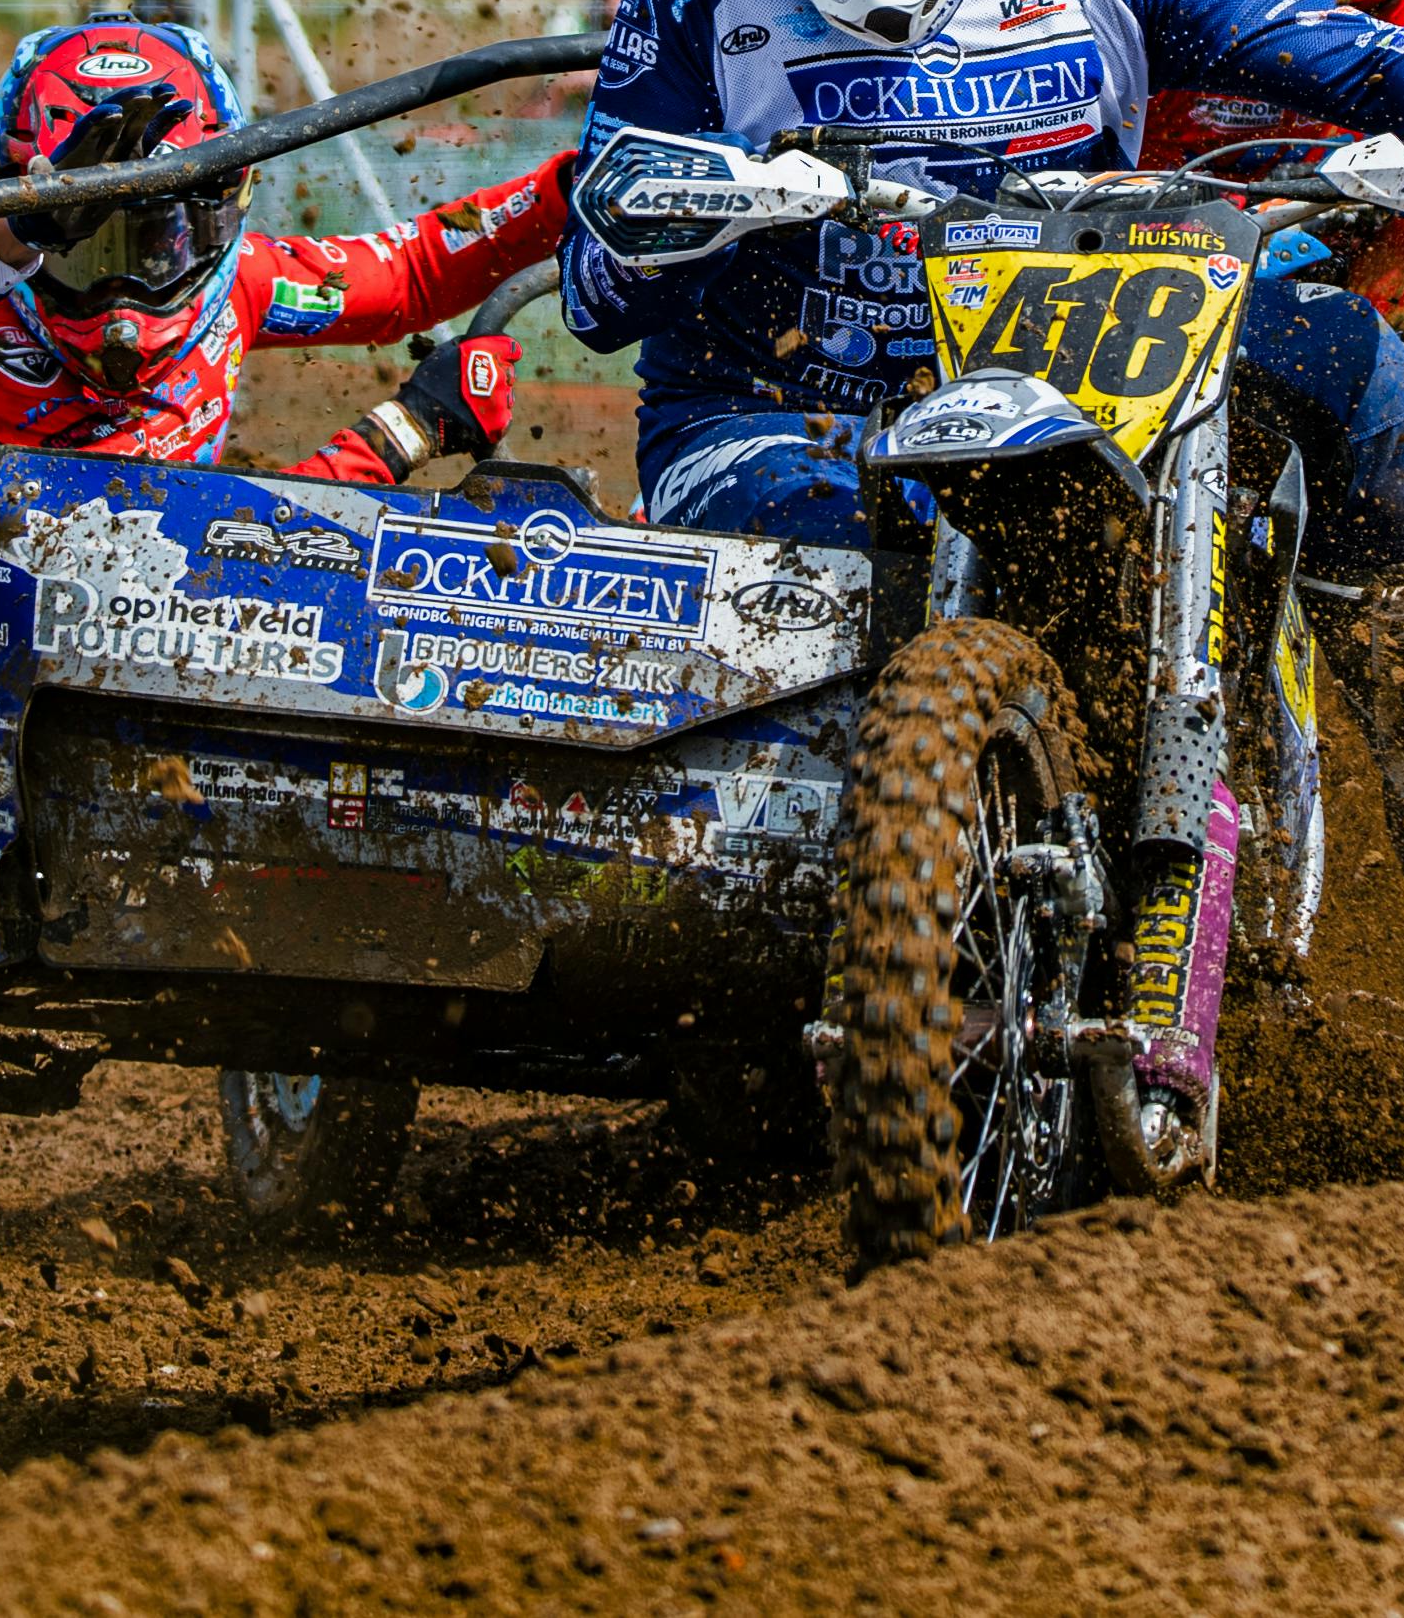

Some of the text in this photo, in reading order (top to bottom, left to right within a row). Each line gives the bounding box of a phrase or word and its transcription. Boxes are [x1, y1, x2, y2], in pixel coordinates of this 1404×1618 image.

[814, 58, 1088, 122] OCKHUIZEN
[949, 114, 1070, 140] BRONBEMALINGEN
[1071, 108, 1087, 121] BV
[627, 190, 753, 213] ACERBIS
[952, 228, 1034, 242] OCKHUIZEN
[961, 266, 1206, 398] 418
[394, 547, 688, 623] OCKHUIZEN
[109, 595, 155, 624] op
[169, 595, 226, 628] het
[507, 618, 527, 634] EN
[668, 636, 687, 652] BV
[415, 636, 675, 695] BROUWERS ZINK
